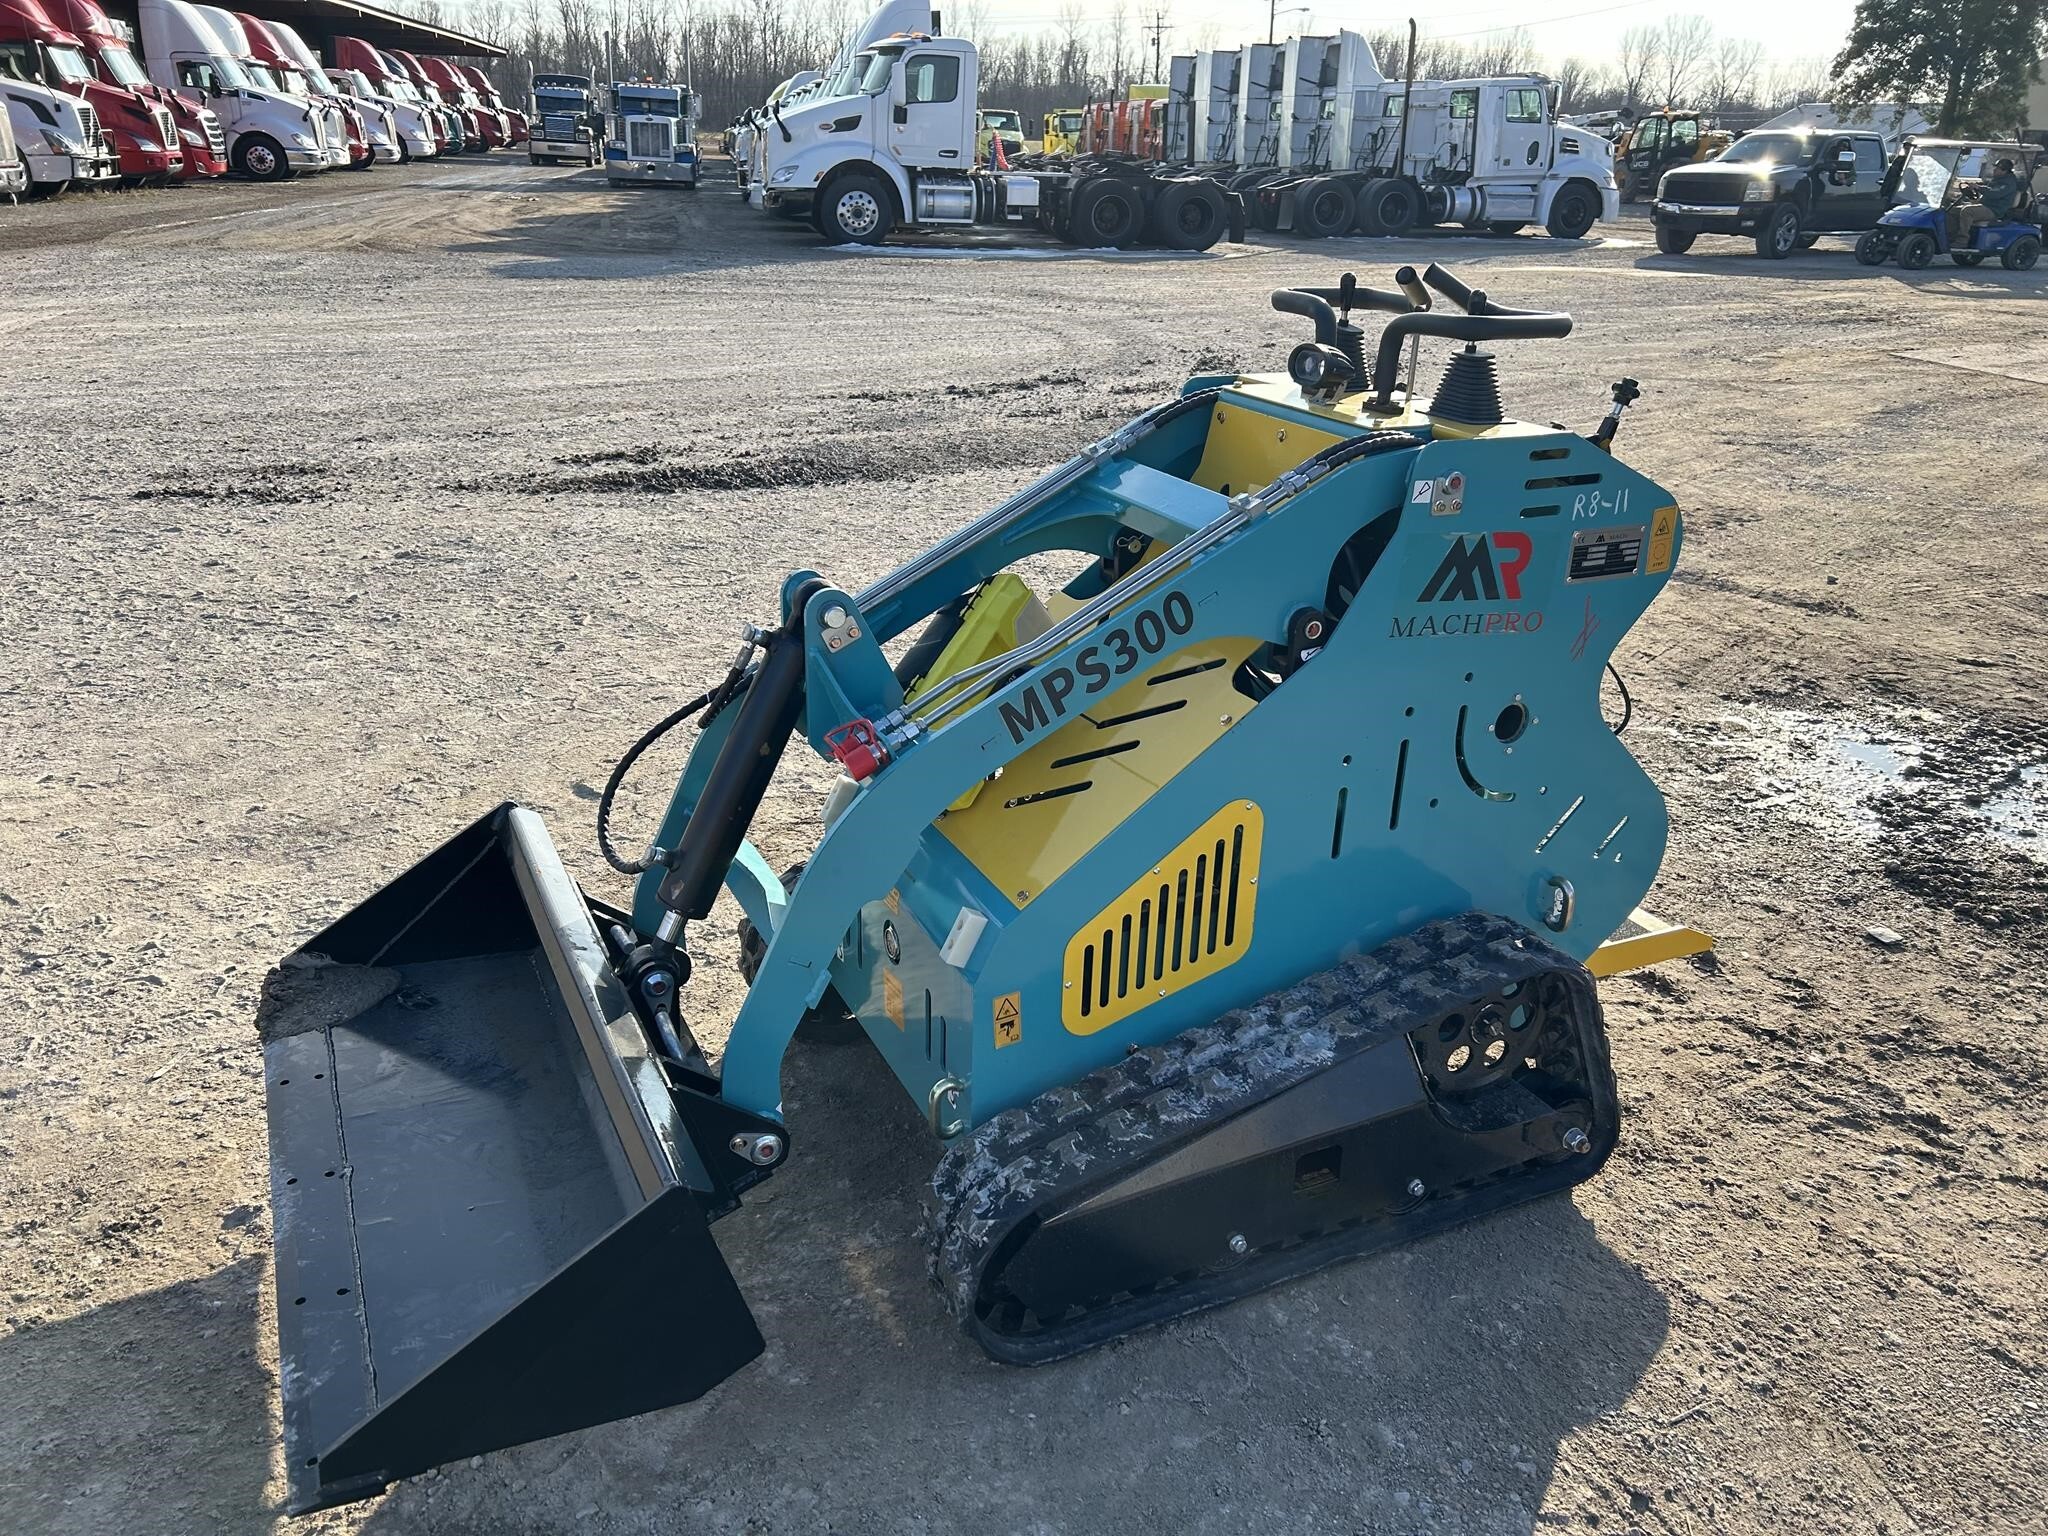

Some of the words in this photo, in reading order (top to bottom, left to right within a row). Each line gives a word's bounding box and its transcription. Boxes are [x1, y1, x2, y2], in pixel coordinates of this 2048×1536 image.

[1572, 488, 1629, 521] R8-11
[1389, 611, 1543, 638] MACHPRO
[998, 591, 1194, 745] MPS300
